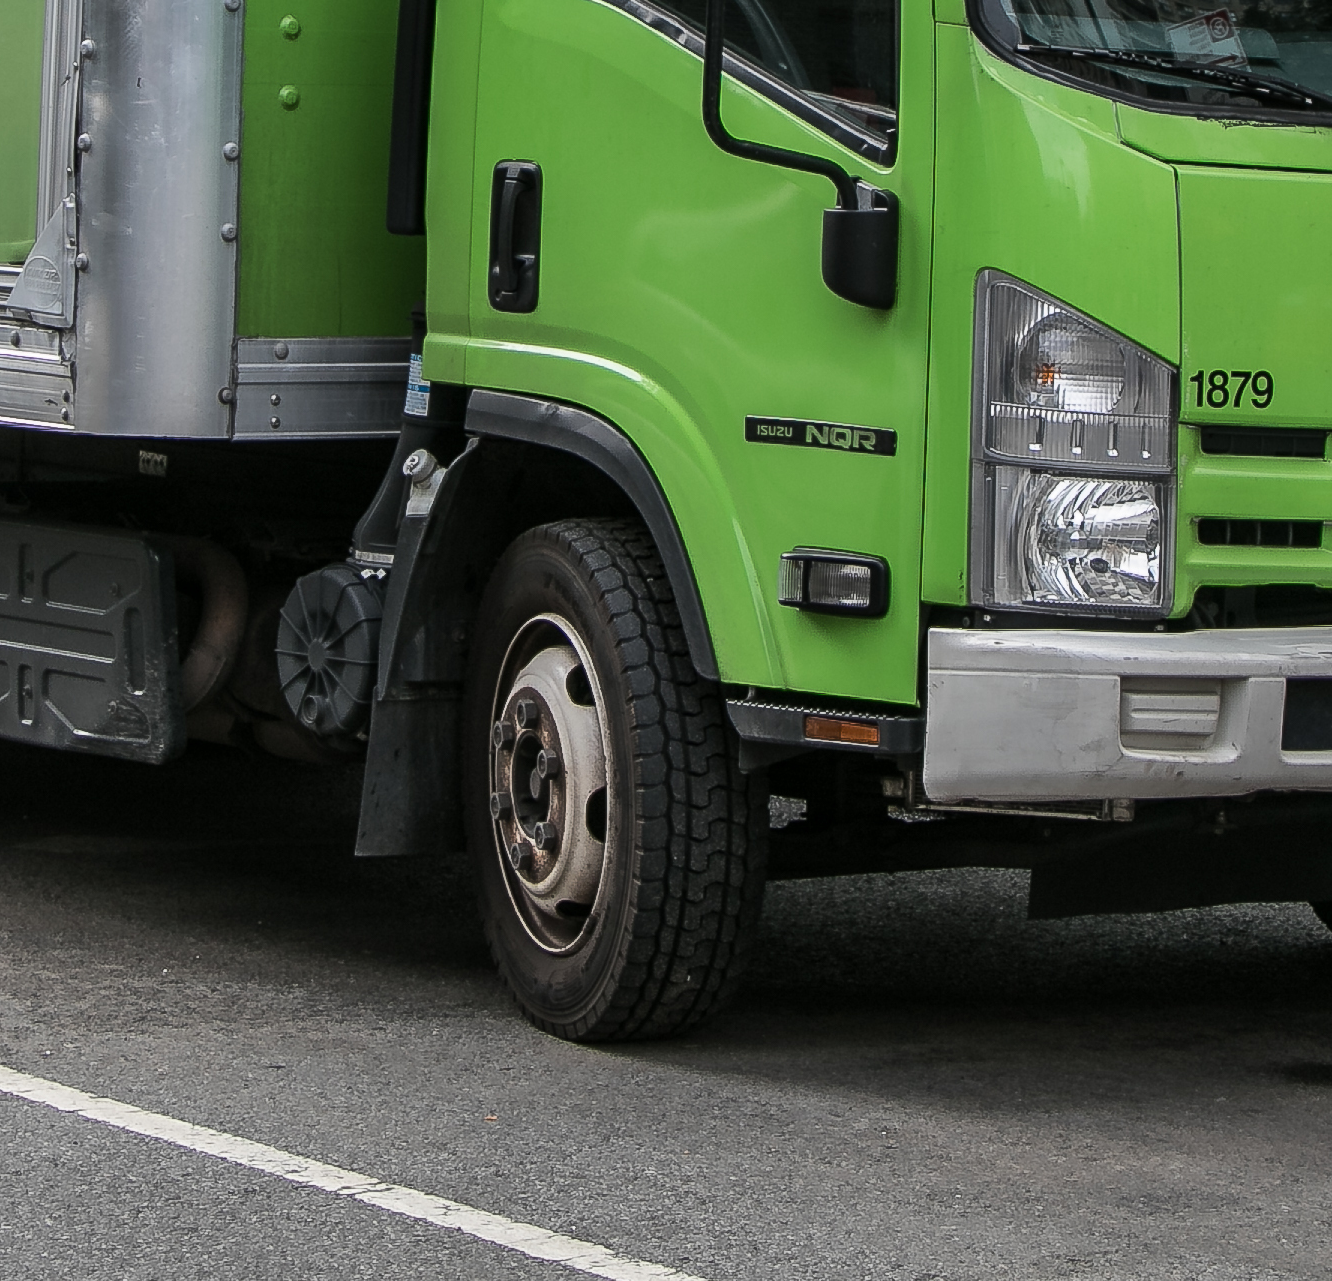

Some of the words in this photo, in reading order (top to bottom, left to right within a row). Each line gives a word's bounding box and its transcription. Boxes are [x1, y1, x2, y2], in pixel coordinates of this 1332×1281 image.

[1188, 369, 1274, 410] 1879
[757, 424, 793, 437] ISUZU
[806, 424, 876, 450] NQR
